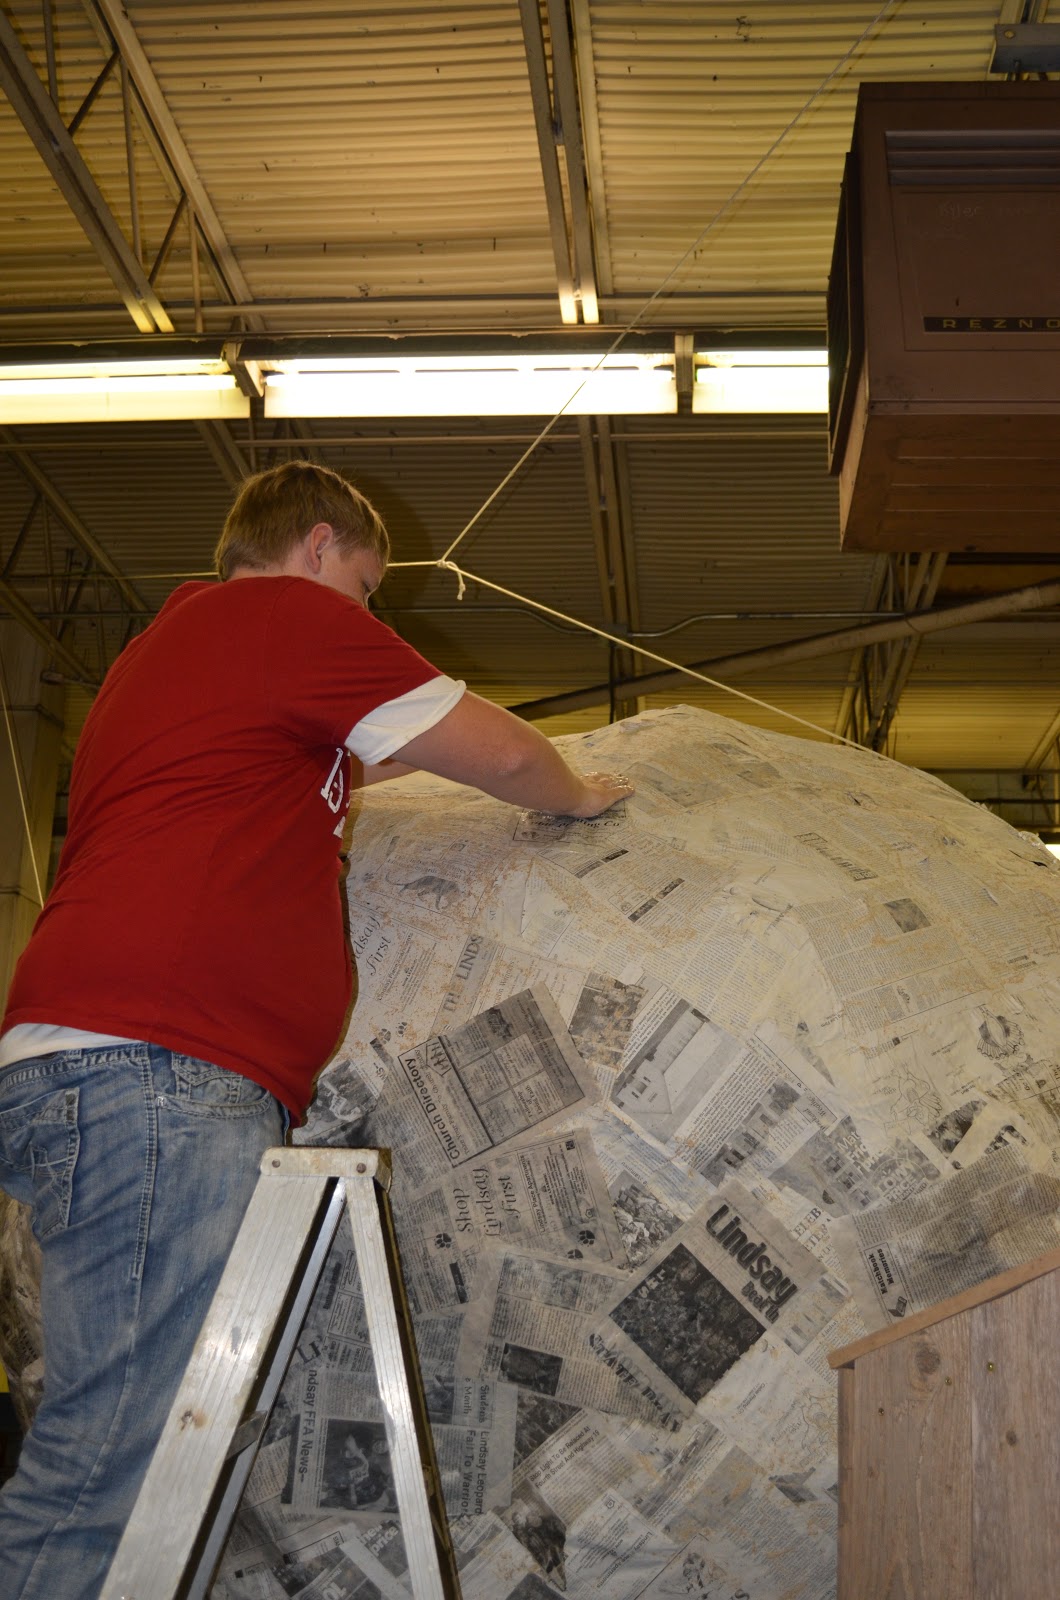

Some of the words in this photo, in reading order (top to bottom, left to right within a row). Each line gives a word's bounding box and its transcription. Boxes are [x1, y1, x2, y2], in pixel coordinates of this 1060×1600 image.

[454, 932, 485, 981] LINDS
[401, 1054, 440, 1114] Directory
[430, 1112, 462, 1161] Church
[450, 1123, 463, 1140] Your
[518, 1153, 534, 1190] Apartments
[447, 1185, 477, 1235] Shop
[468, 1164, 504, 1241] Lindsay
[494, 1174, 521, 1222] First
[528, 1189, 539, 1208] Place
[533, 1207, 546, 1233] Lindsay
[705, 1202, 800, 1309] Lindsay
[867, 1253, 888, 1294] Matchbook
[876, 1247, 894, 1285] Memories
[302, 1409, 316, 1436] FFA
[465, 1428, 476, 1450] Fall
[463, 1454, 474, 1468] To
[475, 1429, 490, 1471] Lindsay
[527, 1468, 543, 1482] Stop
[539, 1457, 555, 1473] Light
[551, 1451, 560, 1461] To
[557, 1445, 567, 1455] Be
[582, 1424, 591, 1433] At
[533, 1471, 552, 1489] Fourth
[548, 1459, 566, 1475] Street
[562, 1451, 575, 1463] And
[572, 1434, 595, 1455] Highway
[591, 1428, 600, 1438] 19
[459, 1470, 472, 1515] Warrior
[472, 1472, 487, 1515] Leopard
[366, 1521, 401, 1557] price
[631, 1530, 653, 1552] Lindsay
